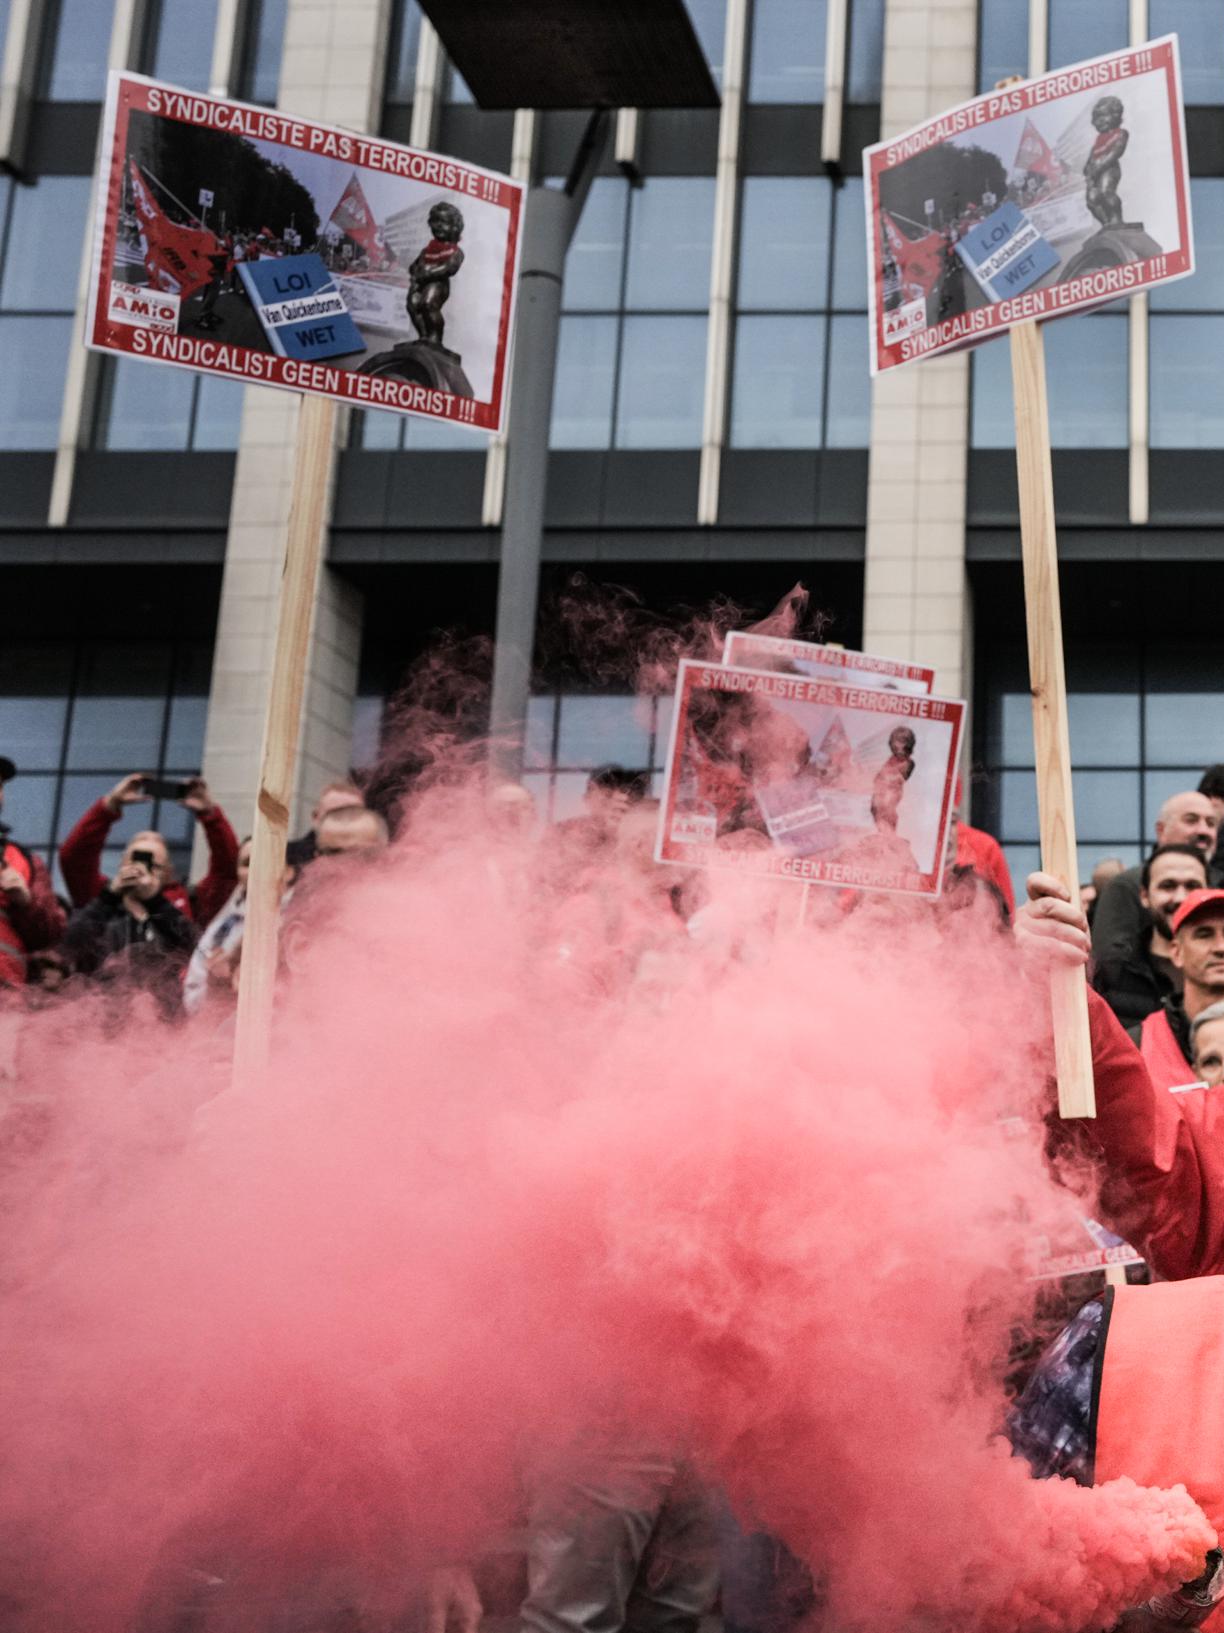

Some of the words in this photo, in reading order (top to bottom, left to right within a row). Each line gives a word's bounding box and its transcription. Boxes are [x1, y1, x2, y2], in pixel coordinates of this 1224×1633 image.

[887, 104, 985, 165] SYNDICALISTE
[989, 92, 1021, 118] PAS
[1025, 56, 1131, 105] TERRORISTE
[1135, 51, 1152, 72] !!!
[147, 88, 304, 147] SYNDICALISTE
[310, 129, 350, 160] PAS
[357, 141, 479, 195] TERRORISTE
[483, 178, 500, 203] !!!
[981, 221, 1010, 250] LOI
[272, 272, 312, 294] LOI
[1004, 254, 1036, 285] WET
[262, 308, 281, 324] Van
[281, 298, 343, 320] Quickenborne
[901, 306, 995, 360] SYNDICALIST
[999, 291, 1045, 321] GEEN
[1049, 262, 1145, 307] TERRORIST
[1150, 256, 1167, 279] !!!
[295, 325, 336, 347] WET
[132, 328, 277, 379] SYNDICALIST
[282, 360, 339, 392] GEEN
[345, 373, 455, 417] TERRORIST
[458, 398, 477, 422] !!!
[700, 671, 804, 699] SYNDICALISTE
[807, 684, 838, 703] PAS
[841, 688, 928, 718] TERRORISTE
[781, 858, 820, 879] GEEN
[824, 863, 903, 889] TERRORIST
